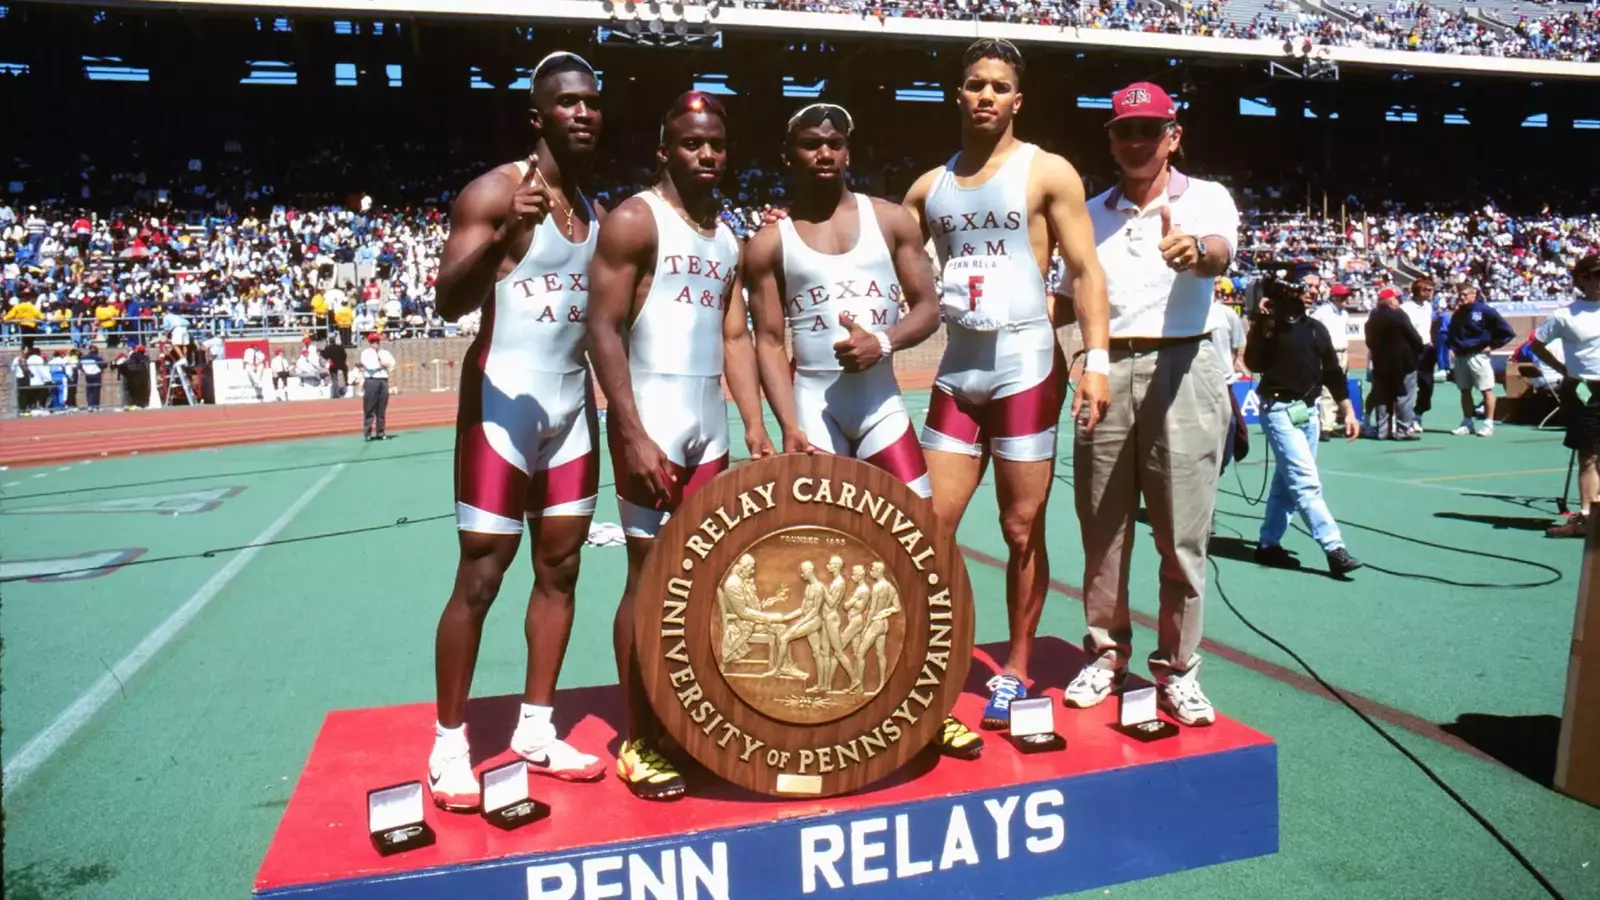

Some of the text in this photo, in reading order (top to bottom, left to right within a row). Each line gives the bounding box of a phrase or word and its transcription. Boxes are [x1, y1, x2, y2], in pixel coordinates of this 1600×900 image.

[929, 211, 1021, 238] TEXAS
[789, 280, 900, 313] TEXAS
[968, 275, 985, 312] F
[686, 477, 935, 571] RELAY CARNIVAL
[661, 576, 952, 773] UNIVERSITY OF PENNSYLVANIA
[526, 788, 1065, 900] PENN RELAYS
